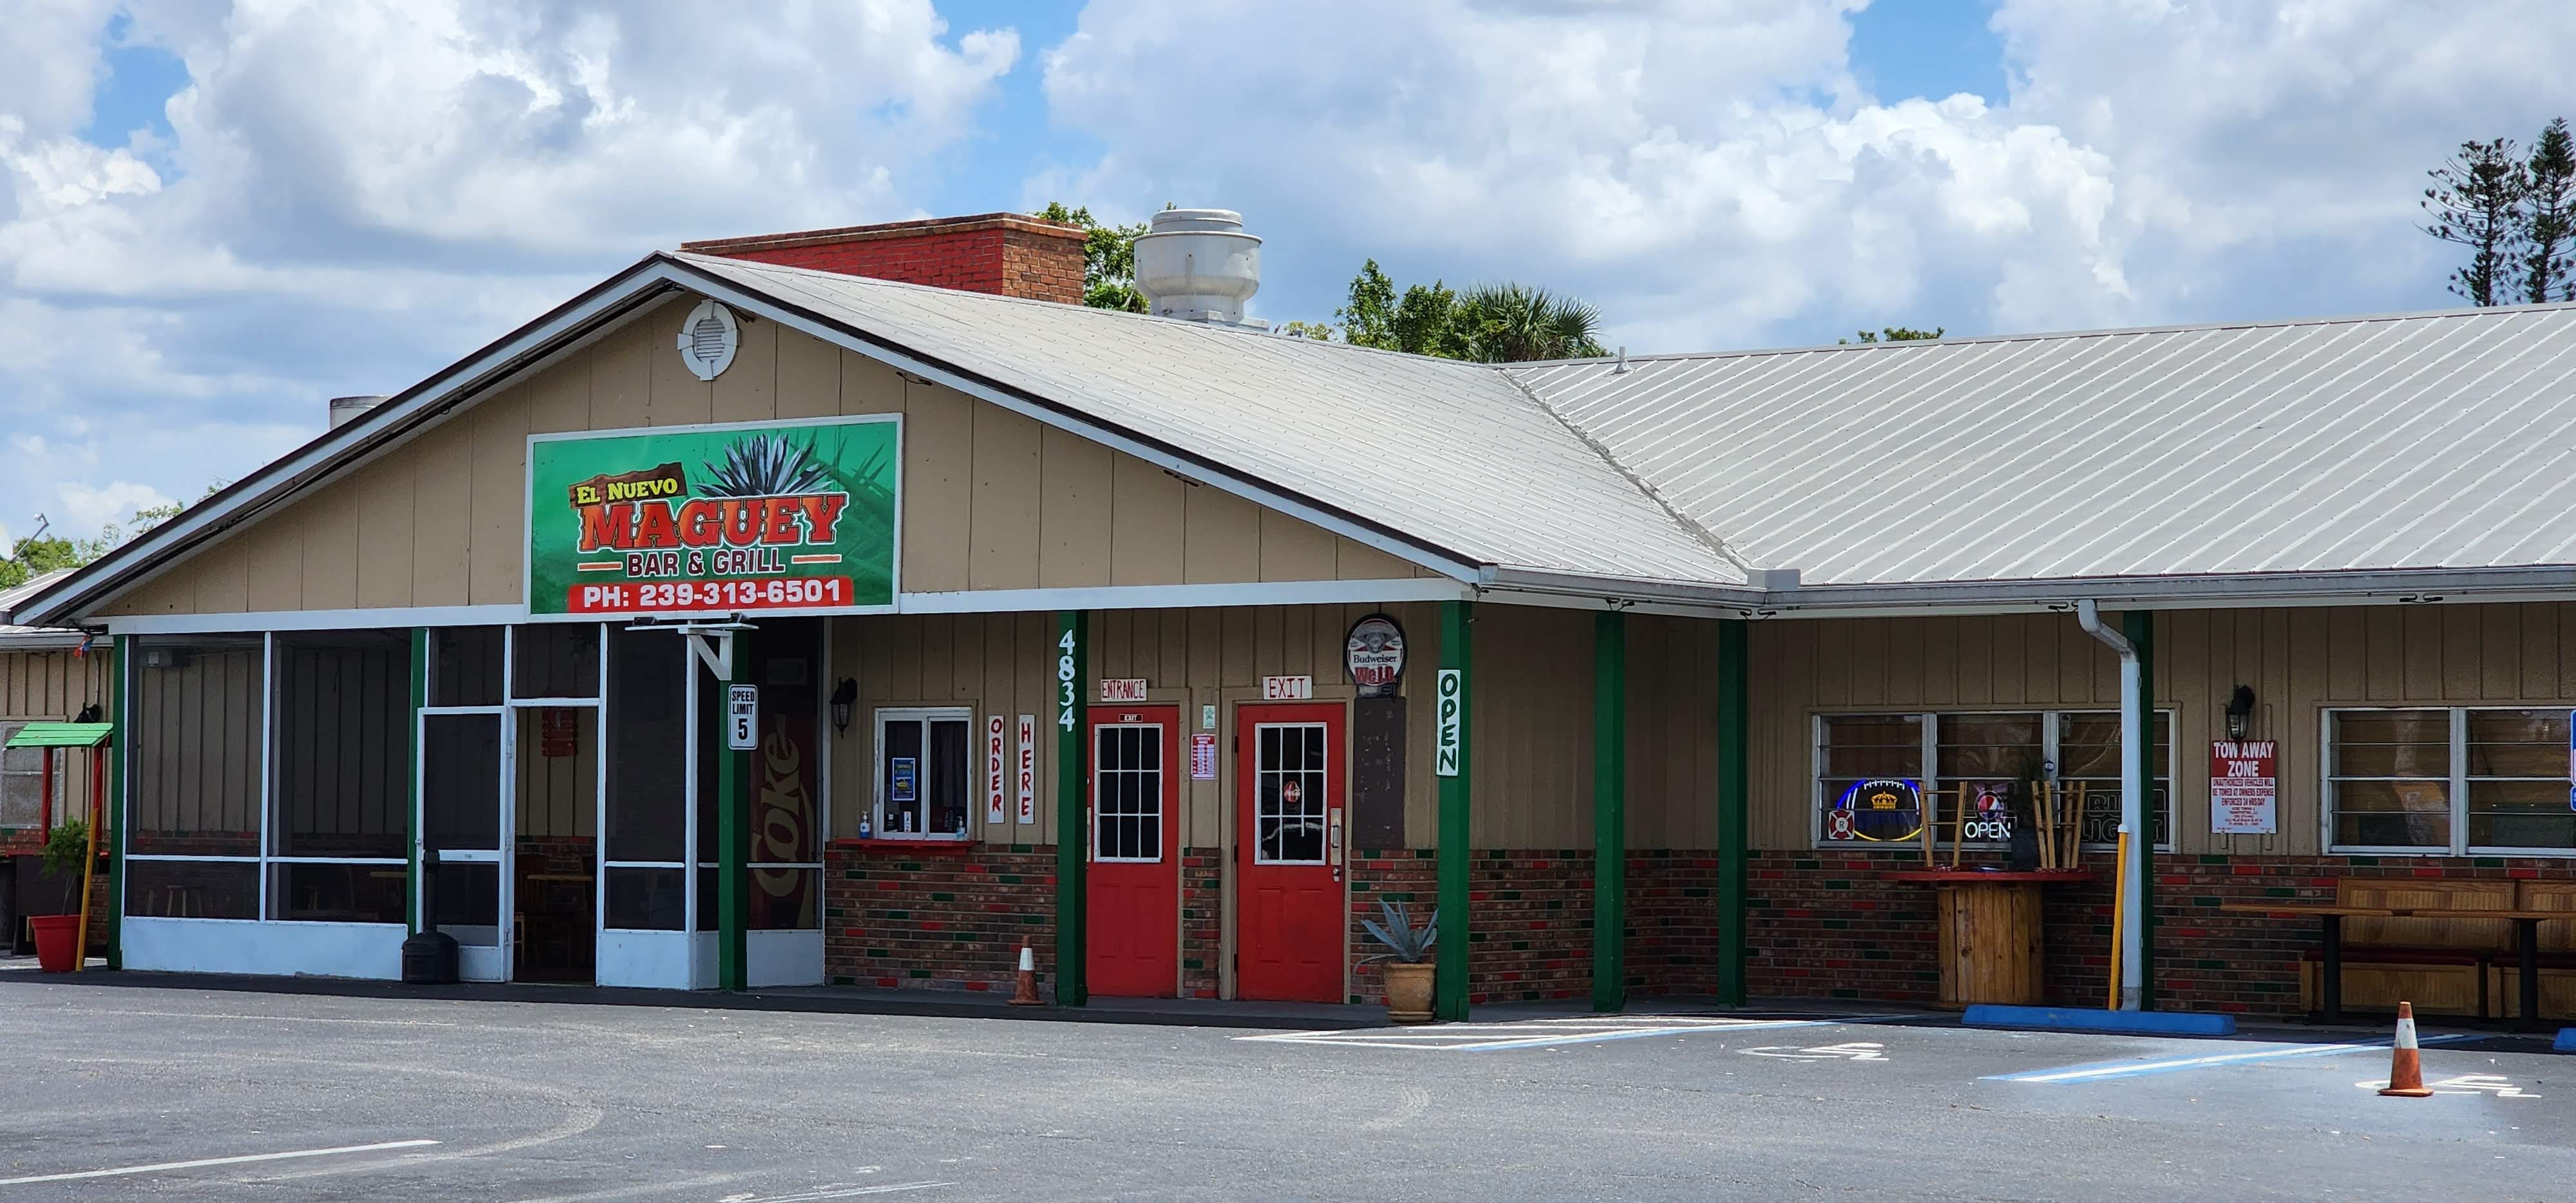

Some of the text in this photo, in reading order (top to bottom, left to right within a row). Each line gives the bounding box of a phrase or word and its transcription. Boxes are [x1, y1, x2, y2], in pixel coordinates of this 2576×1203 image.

[577, 478, 678, 504] EL NUEVO
[579, 493, 848, 551] MAGUEY
[627, 548, 786, 577] BAR & GRILL
[583, 579, 840, 608] PH: 239-313-6501
[1353, 654, 1397, 663] Budweiser
[1058, 629, 1075, 732] 4834
[1102, 680, 1144, 699] ENTRANCE
[1269, 677, 1305, 698] EXIT
[732, 690, 755, 703] SPEED
[732, 703, 754, 715] LIMIT
[737, 717, 748, 741] 5
[1440, 673, 1458, 772] OPEN
[2213, 742, 2274, 759] TOW AWAY
[990, 718, 1003, 813] ORDER
[1020, 722, 1032, 817] HERE
[2228, 761, 2259, 777] ZONE
[1965, 821, 2012, 839] OPEN
